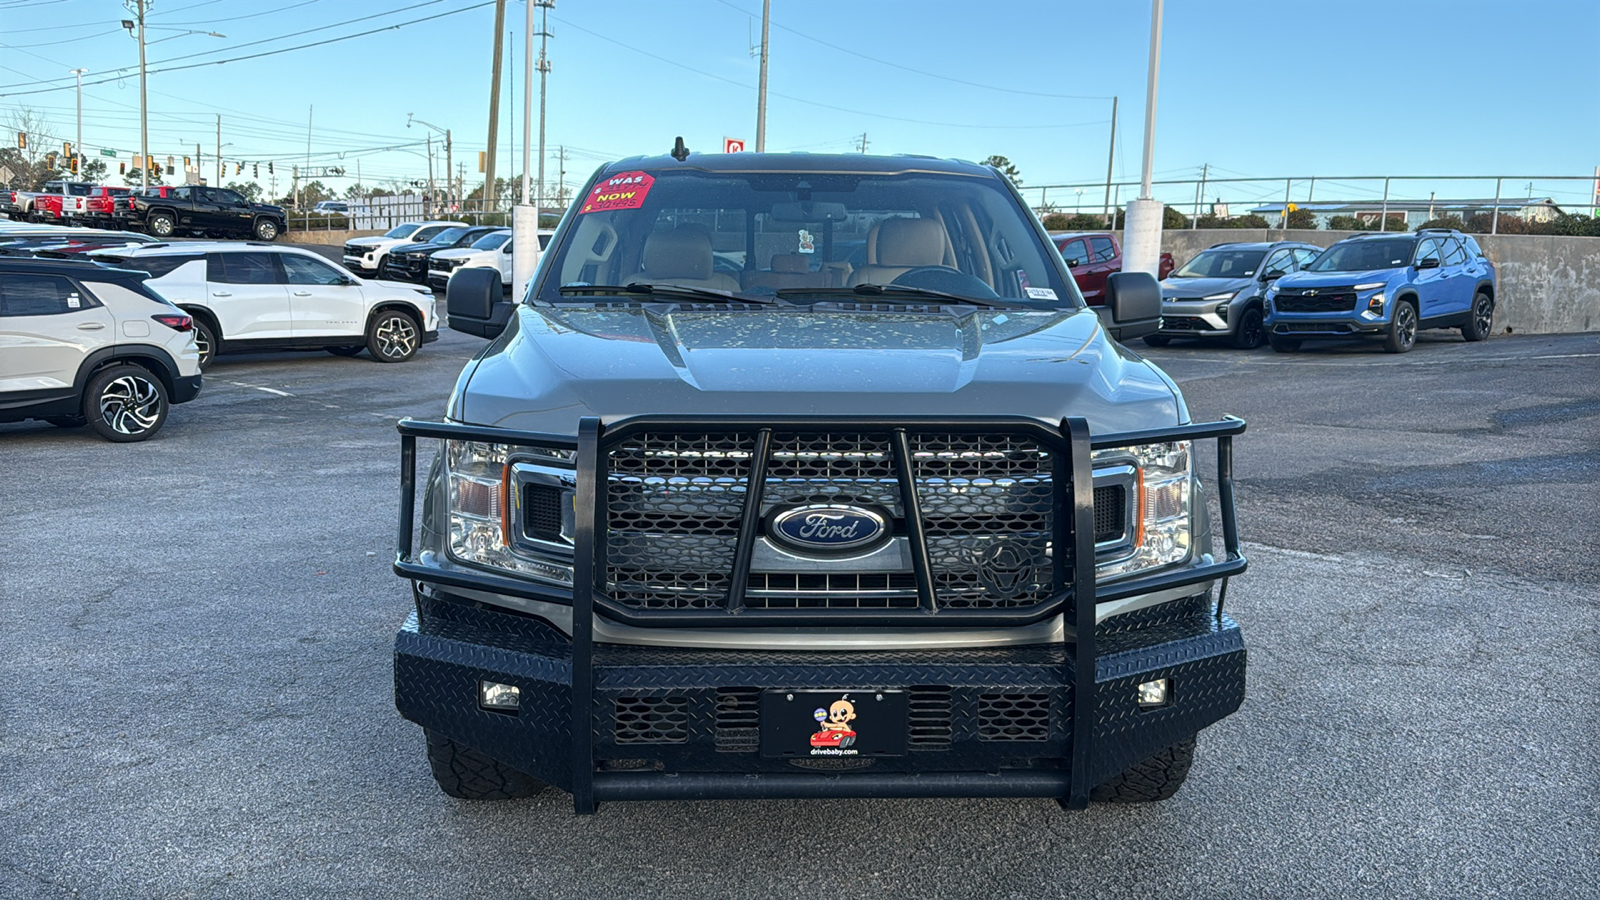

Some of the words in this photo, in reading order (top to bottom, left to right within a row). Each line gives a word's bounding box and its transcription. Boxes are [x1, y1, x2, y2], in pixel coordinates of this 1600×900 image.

[609, 176, 643, 186] WAS
[597, 192, 636, 202] NOW
[800, 514, 859, 538] Ford
